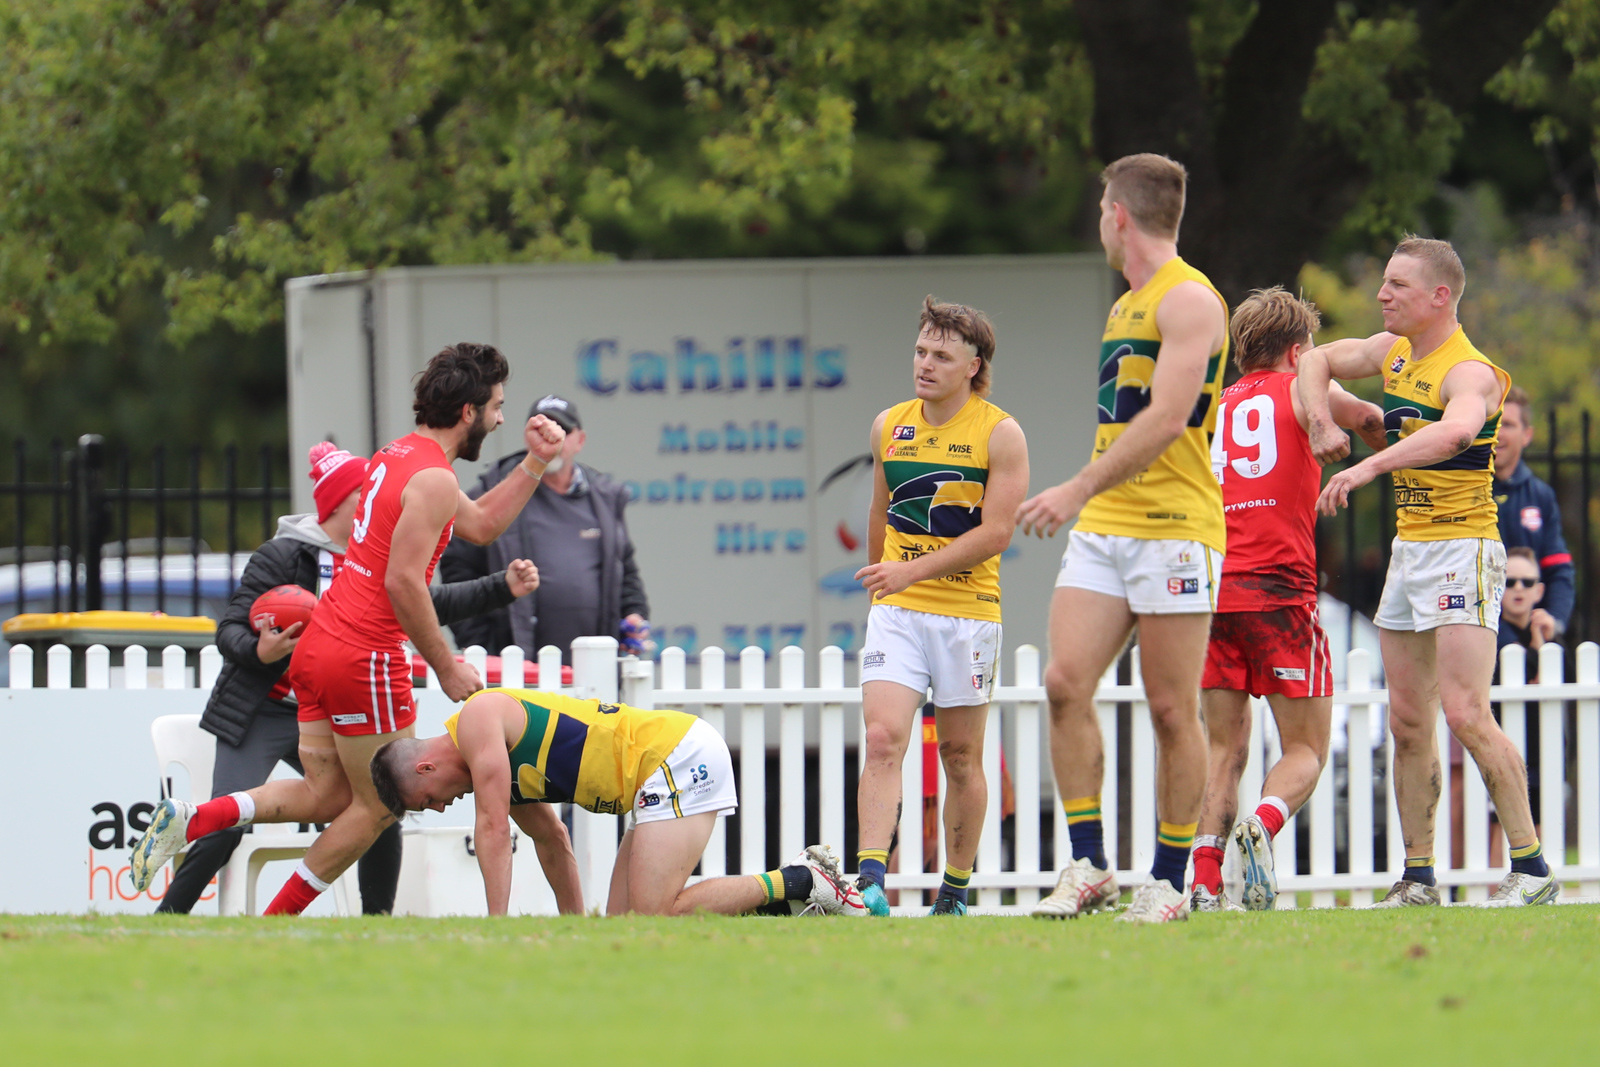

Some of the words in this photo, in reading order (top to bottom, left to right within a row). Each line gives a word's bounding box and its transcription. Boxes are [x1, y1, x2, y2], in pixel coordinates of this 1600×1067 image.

[577, 336, 847, 396] Cahills
[658, 419, 805, 453] Mobile
[948, 443, 973, 453] WISE
[1210, 394, 1278, 485] 49
[353, 462, 387, 544] 3
[610, 473, 806, 504] oolroom
[1222, 499, 1277, 513] PYWORLD
[716, 522, 807, 554] Hire
[688, 779, 715, 792] Incredible
[693, 787, 712, 797] Smiles
